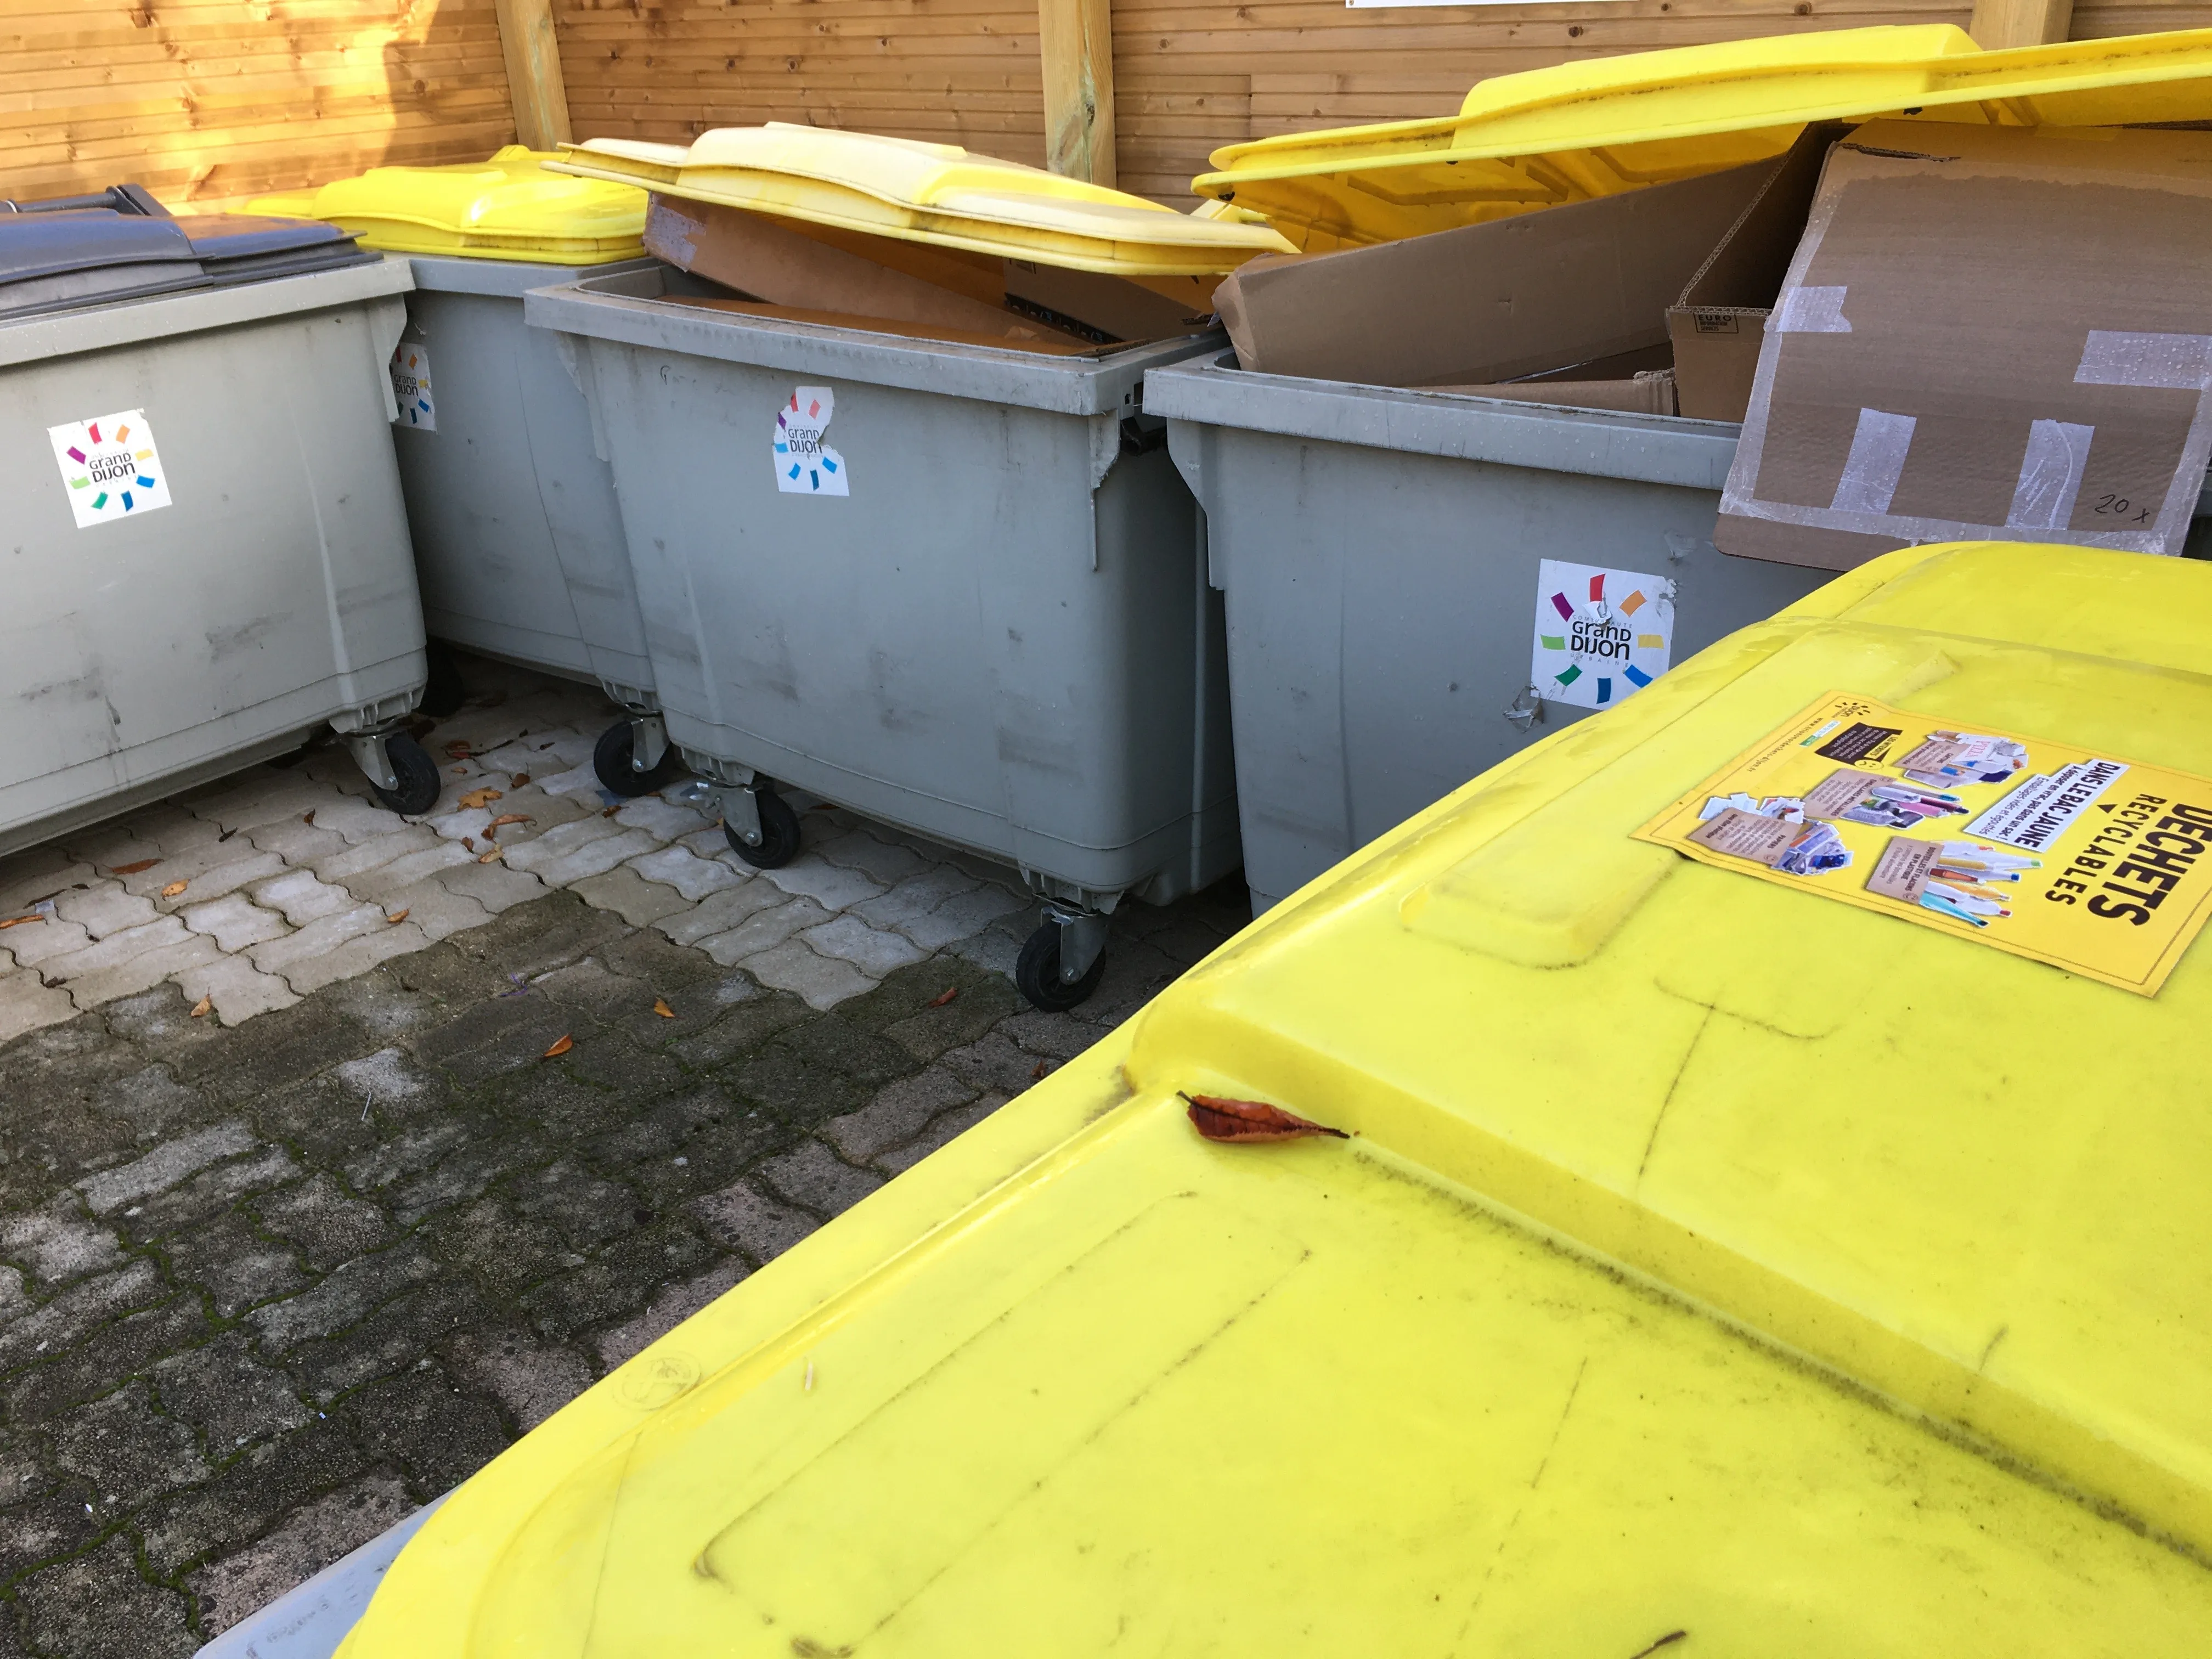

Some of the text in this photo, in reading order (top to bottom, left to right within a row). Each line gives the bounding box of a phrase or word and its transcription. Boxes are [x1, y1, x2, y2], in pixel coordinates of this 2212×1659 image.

[2094, 493, 2130, 514] 20
[1964, 741, 1991, 758] PIZZA
[2054, 769, 2079, 786] déposer
[2016, 777, 2050, 800] Emballages
[2014, 762, 2121, 848] DANS LE BAC JAUNE
[2027, 800, 2042, 810] pas
[2015, 809, 2034, 821] dans
[1999, 827, 2014, 837] sac
[2045, 793, 2168, 905] RECYCLABLES
